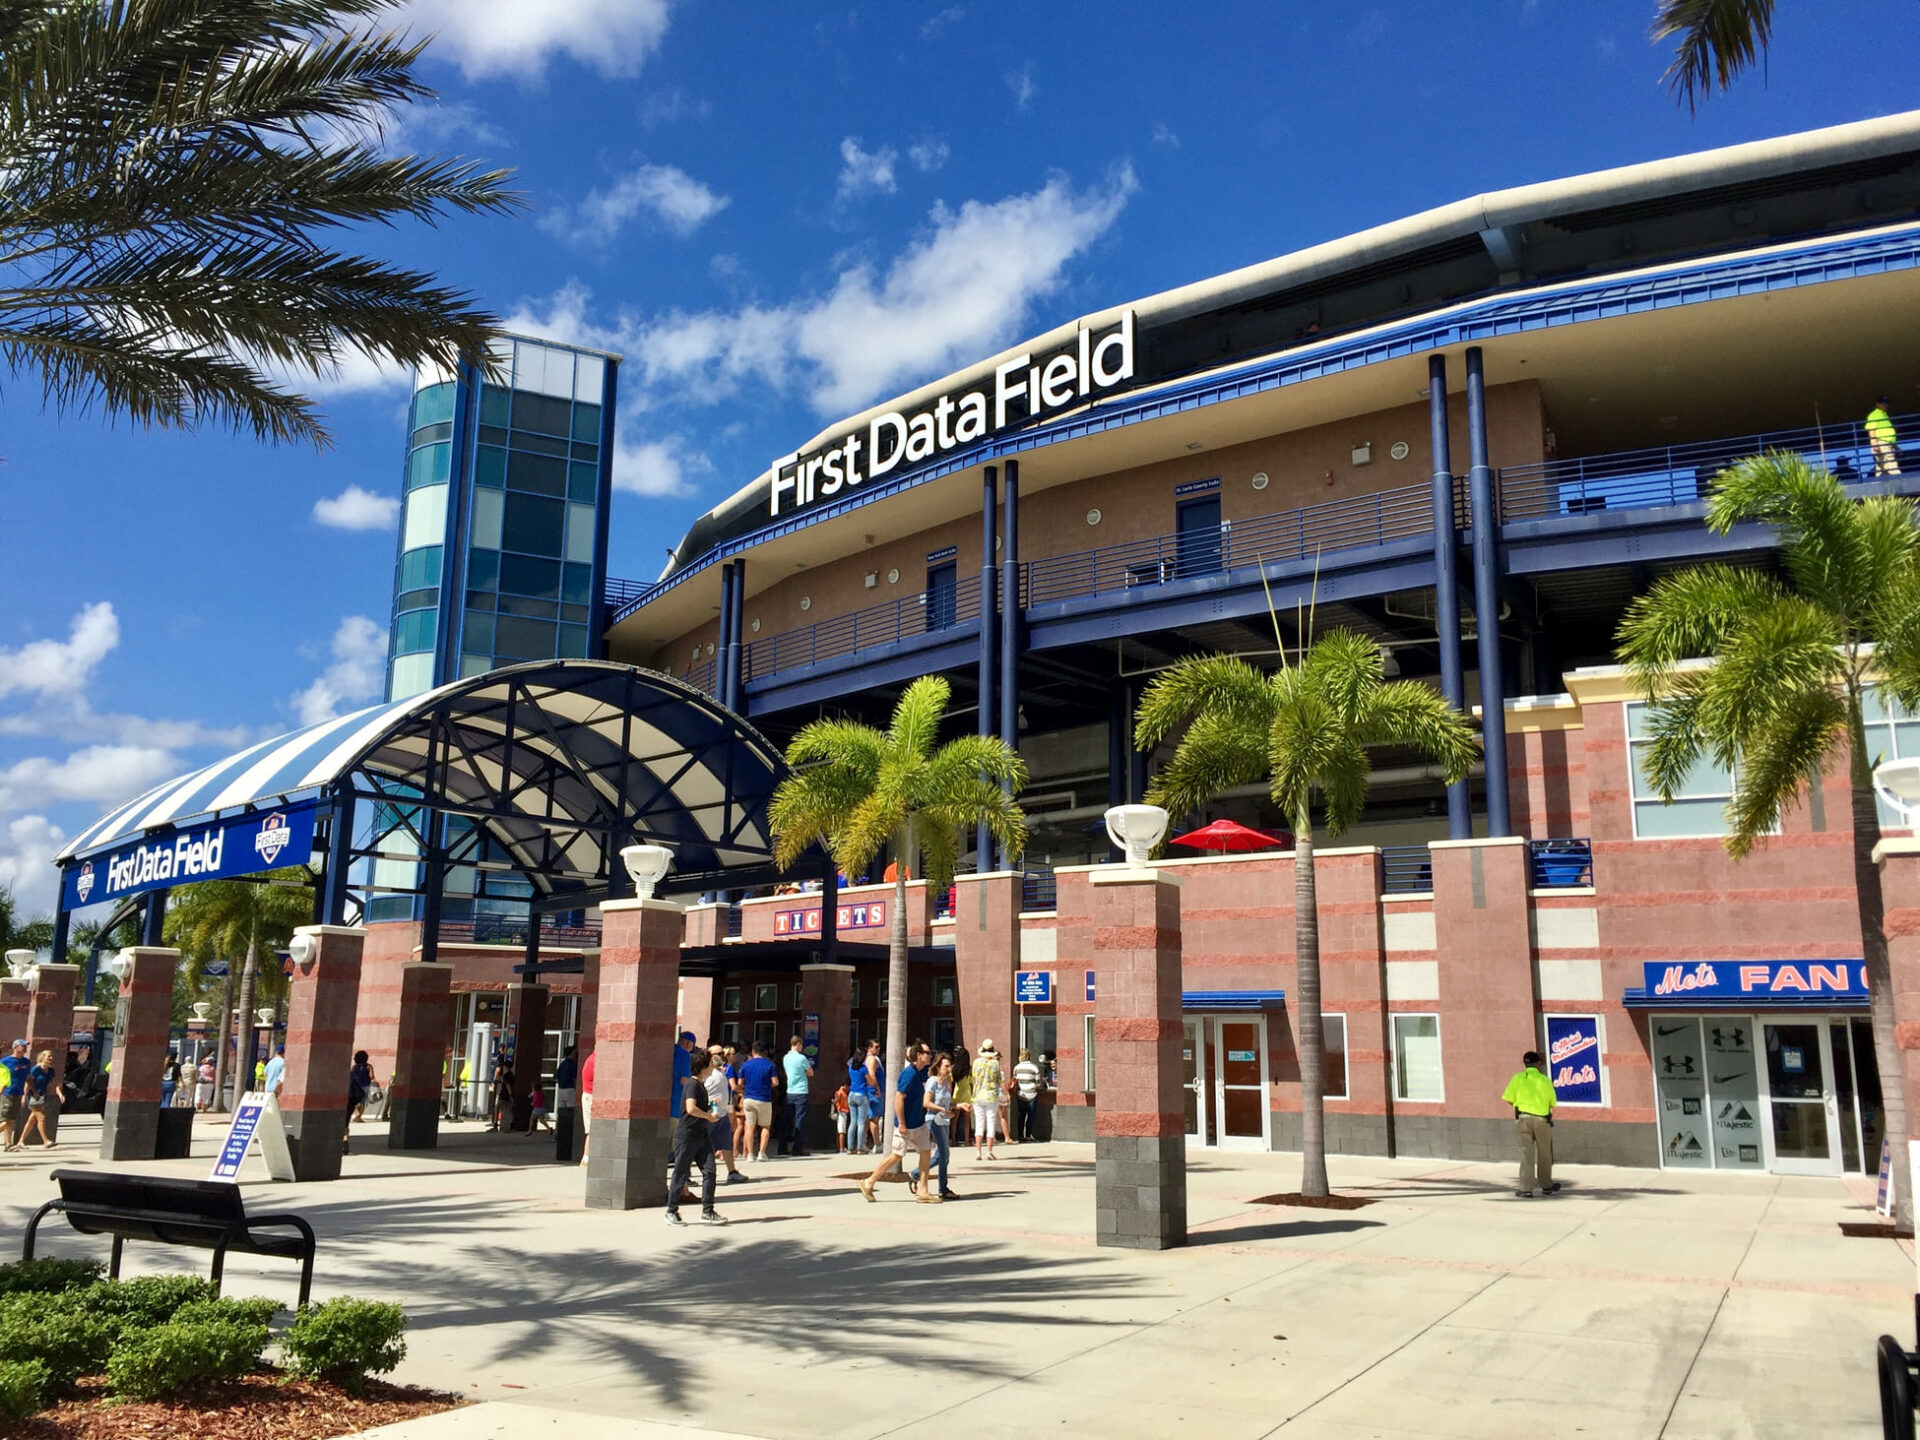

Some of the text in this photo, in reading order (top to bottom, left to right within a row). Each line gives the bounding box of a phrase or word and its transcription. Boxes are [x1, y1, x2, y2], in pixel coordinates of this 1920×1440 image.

[770, 309, 1136, 516] First Data Field
[106, 826, 225, 894] First Data Field
[777, 906, 882, 931] TICETS
[1655, 963, 1717, 995] Mets
[1740, 965, 1850, 992] FAN
[1554, 1065, 1596, 1087] Mets
